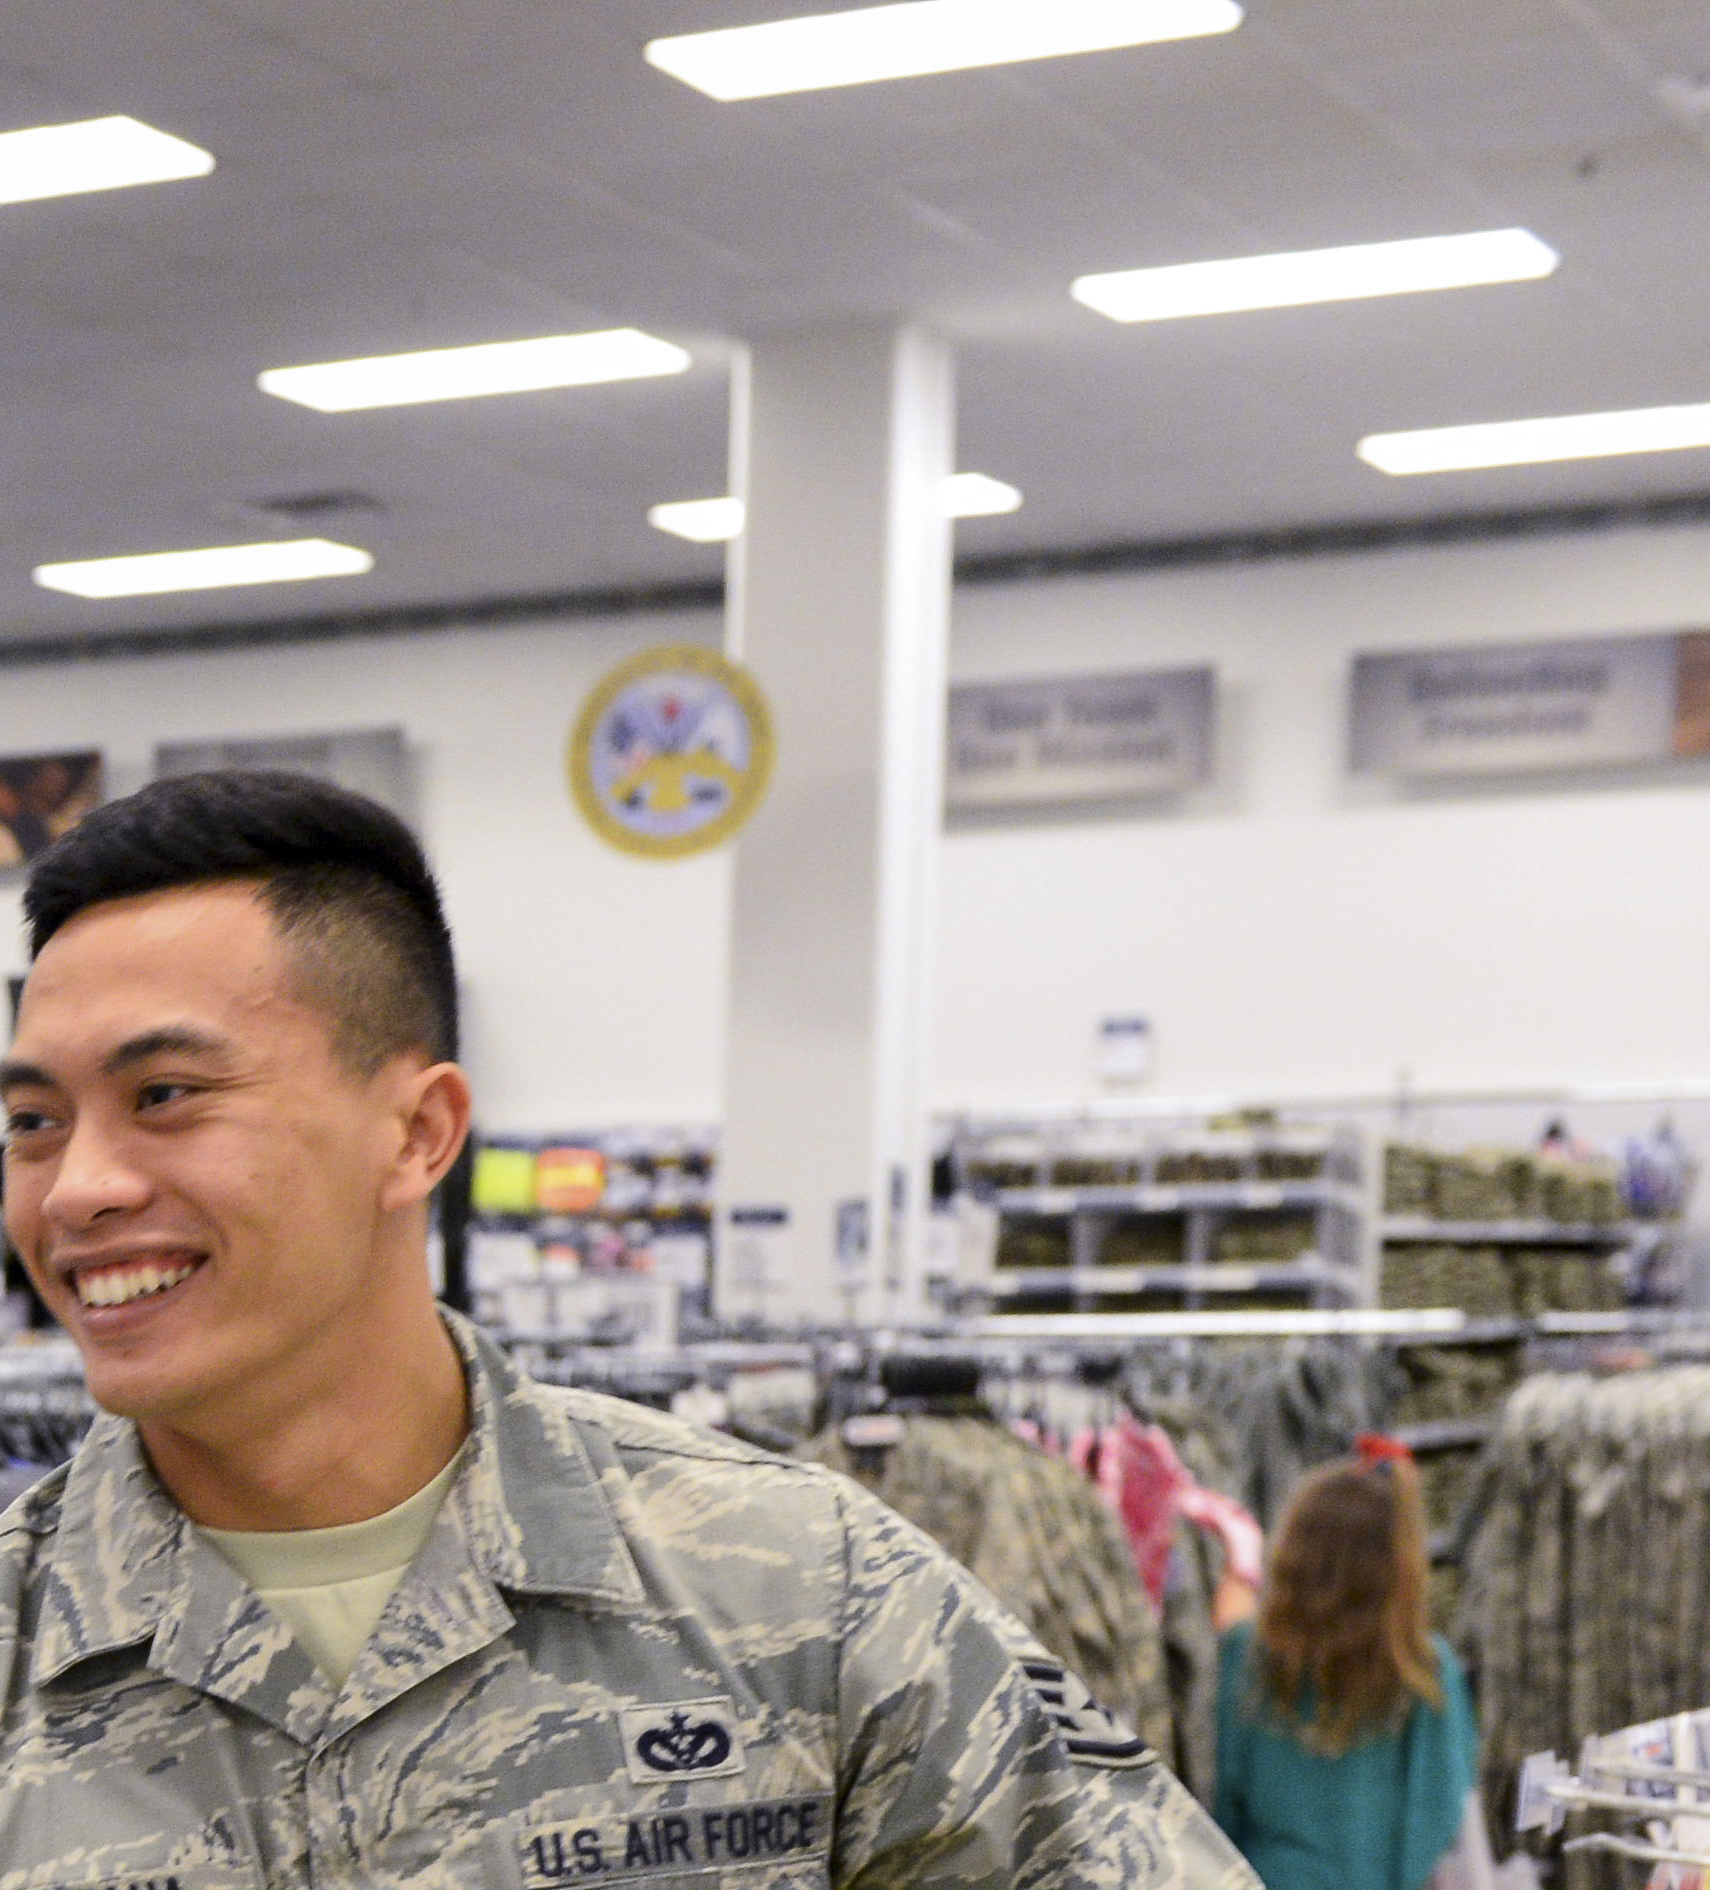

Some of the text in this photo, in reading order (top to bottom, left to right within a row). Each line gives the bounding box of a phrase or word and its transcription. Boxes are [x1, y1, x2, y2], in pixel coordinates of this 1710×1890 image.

[530, 1801, 818, 1879] U.S. AIR FORCE
